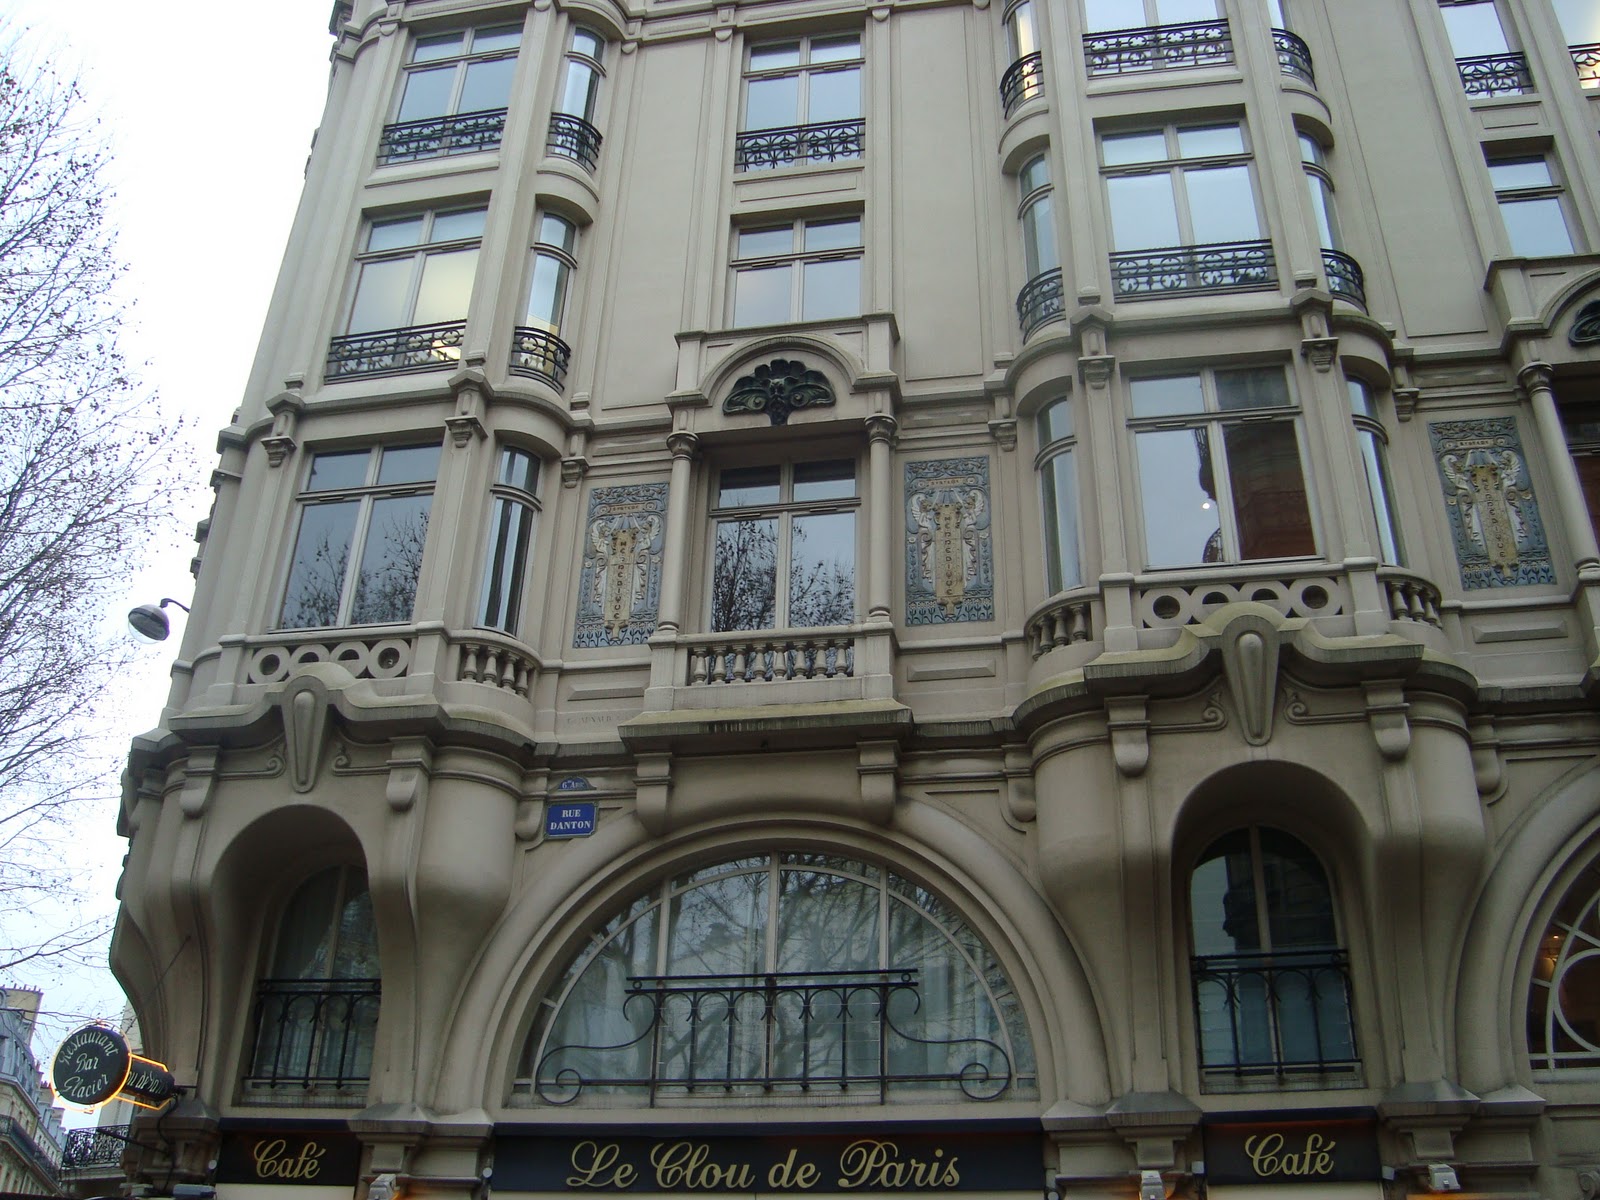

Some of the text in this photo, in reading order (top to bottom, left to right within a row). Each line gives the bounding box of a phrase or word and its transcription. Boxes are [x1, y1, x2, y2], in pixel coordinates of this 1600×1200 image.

[550, 820, 592, 830] DANTON
[562, 809, 581, 818] RUE
[58, 1031, 119, 1066] Restaurant
[75, 1052, 99, 1073] Bar
[62, 1074, 109, 1098] Glacier
[253, 1139, 326, 1179] Café
[565, 1139, 961, 1189] Le Clou de Paris
[1244, 1133, 1337, 1177] Café
